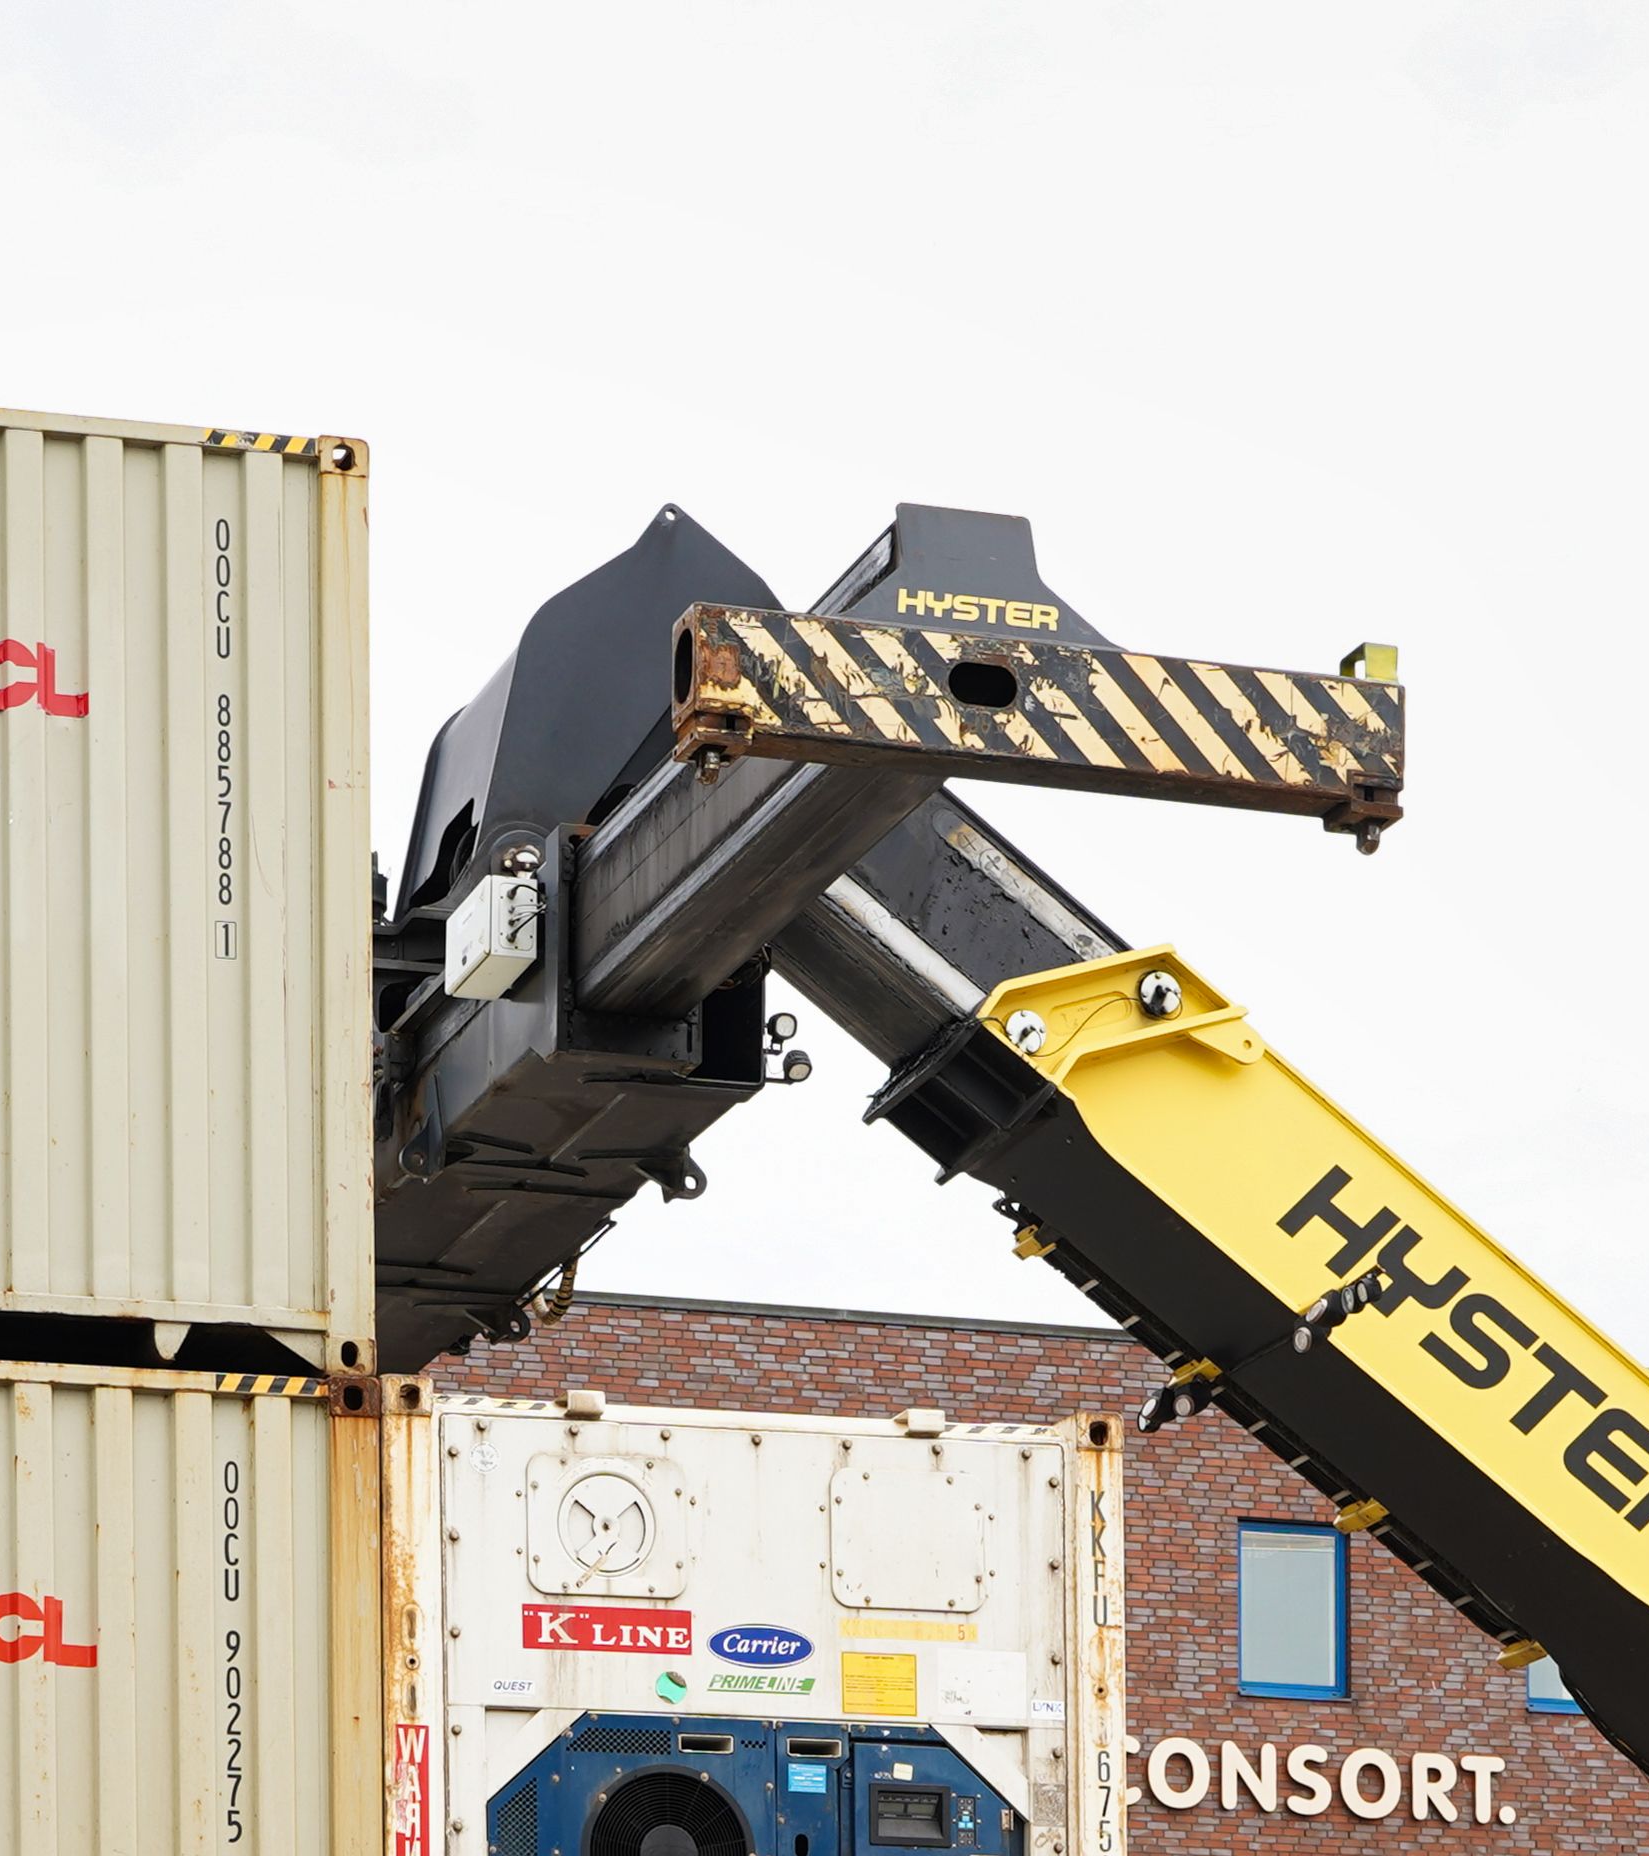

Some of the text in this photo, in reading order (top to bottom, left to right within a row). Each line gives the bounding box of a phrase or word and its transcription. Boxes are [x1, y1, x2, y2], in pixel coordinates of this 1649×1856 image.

[214, 518, 232, 661] OOCU
[897, 587, 1060, 632] HYSTER
[216, 694, 234, 908] 885788
[223, 1460, 240, 1602] OOCU
[1090, 1489, 1108, 1628] KKFU
[592, 1623, 691, 1649] LINE
[723, 1633, 801, 1656] Carrier
[493, 1680, 533, 1692] QUEST
[1032, 1702, 1062, 1713] LYNX
[225, 1630, 243, 1844] 902275
[1126, 1736, 1517, 1828] ONSORT.
